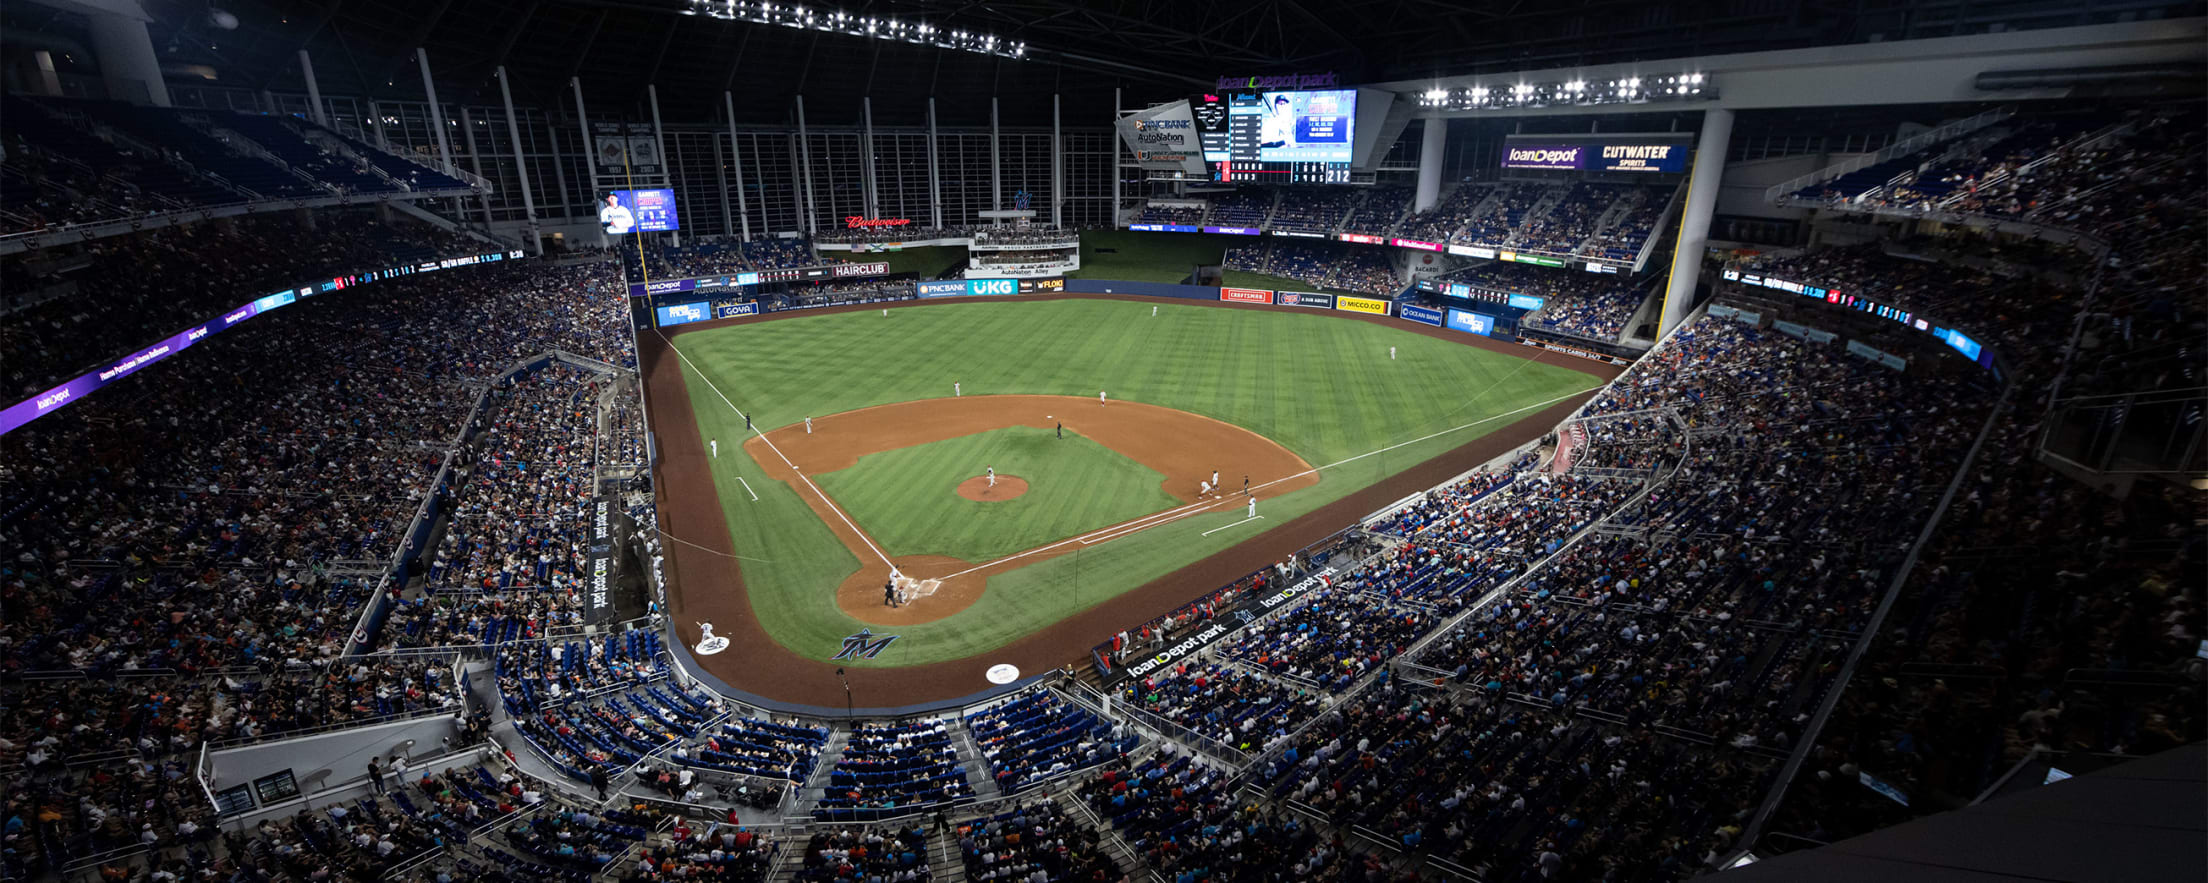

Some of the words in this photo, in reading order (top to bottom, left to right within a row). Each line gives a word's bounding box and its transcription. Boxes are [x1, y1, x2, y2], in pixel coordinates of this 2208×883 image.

[1299, 71, 1337, 90] park
[1138, 132, 1183, 142] AutoNation
[1509, 148, 1578, 164] loanDepot
[1603, 146, 1670, 159] CUTWATER
[1619, 159, 1646, 167] SPIRITS
[1327, 170, 1335, 182] 2
[1342, 170, 1350, 182] 2
[845, 216, 910, 228] Budweiser
[835, 264, 885, 277] HAIRCLUB
[974, 281, 1012, 294] UKG
[1045, 280, 1063, 288] FLOKI
[1230, 292, 1263, 300] CRAFTSMAN
[726, 306, 751, 316] GOYA
[1347, 301, 1381, 310] MICCO.CO
[1408, 311, 1427, 319] OCEAN
[1426, 313, 1440, 322] BANK
[1545, 344, 1567, 352] SPORTS
[1567, 348, 1587, 357] CARDS
[100, 369, 116, 382] Home
[113, 358, 137, 376] Purchase
[37, 388, 71, 410] loanDepot
[591, 558, 609, 592] loanDepot
[1260, 576, 1317, 608] loanDepot
[590, 591, 608, 609] park
[1126, 637, 1200, 678] loanDepot
[1196, 623, 1227, 644] park
